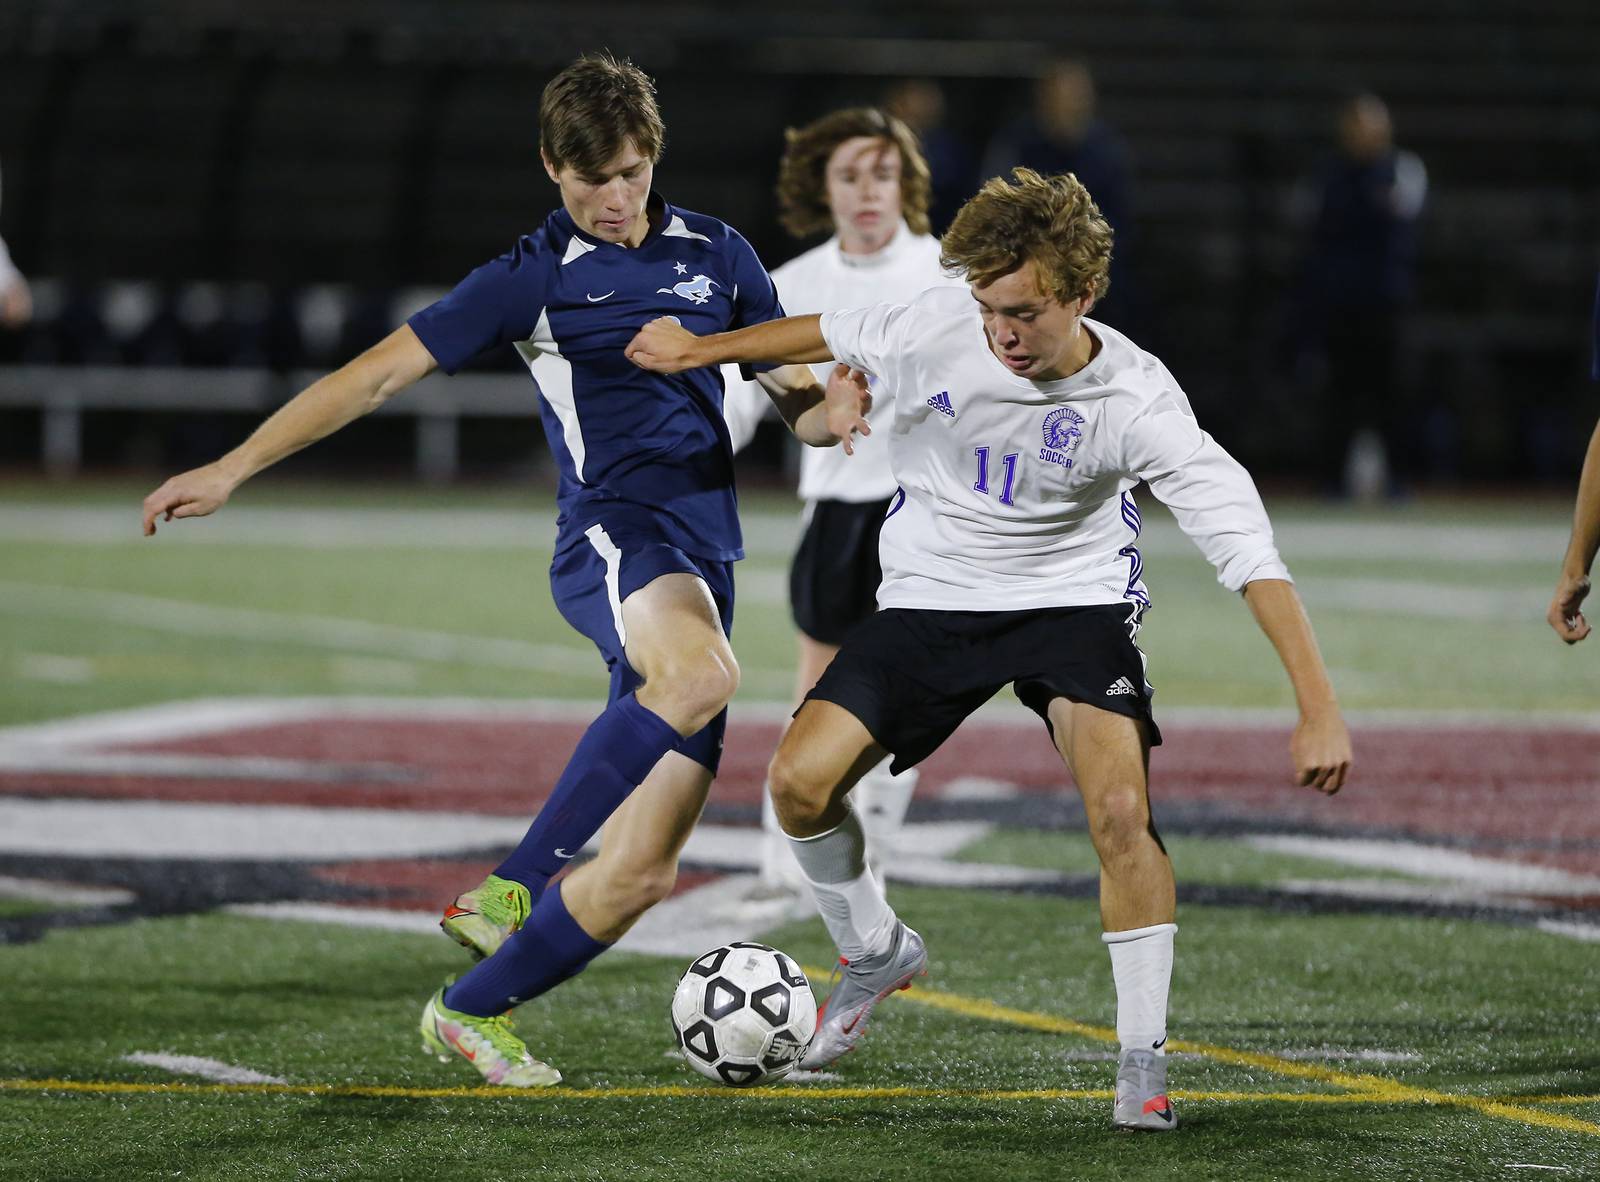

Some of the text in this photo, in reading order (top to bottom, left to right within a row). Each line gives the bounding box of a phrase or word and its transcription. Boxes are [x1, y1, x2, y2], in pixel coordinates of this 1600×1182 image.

[926, 399, 956, 418] adidas
[974, 446, 1019, 507] 11
[1105, 686, 1138, 698] adida
